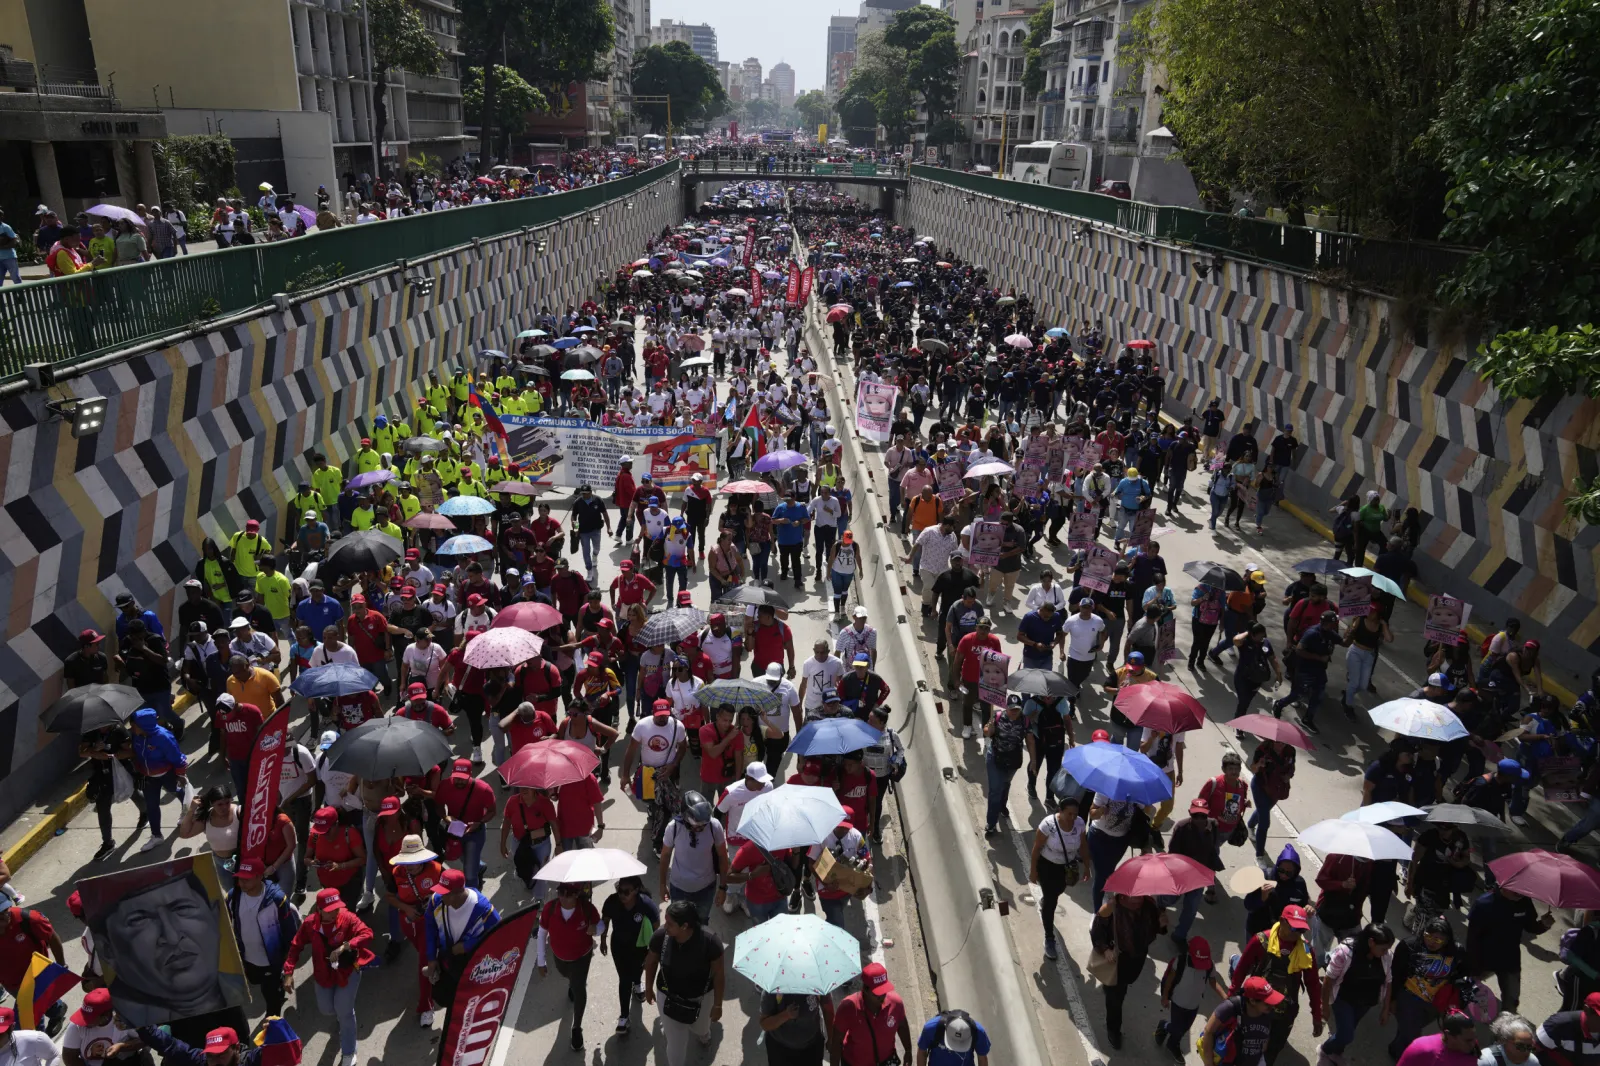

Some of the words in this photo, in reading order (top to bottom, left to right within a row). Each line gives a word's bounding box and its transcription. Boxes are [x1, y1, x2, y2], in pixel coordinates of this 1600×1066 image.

[537, 418, 577, 427] COMUNAS
[250, 753, 278, 847] SALUD
[455, 1028, 470, 1060] POPULAR
[464, 1007, 475, 1029] PARA
[470, 997, 478, 1008] LA
